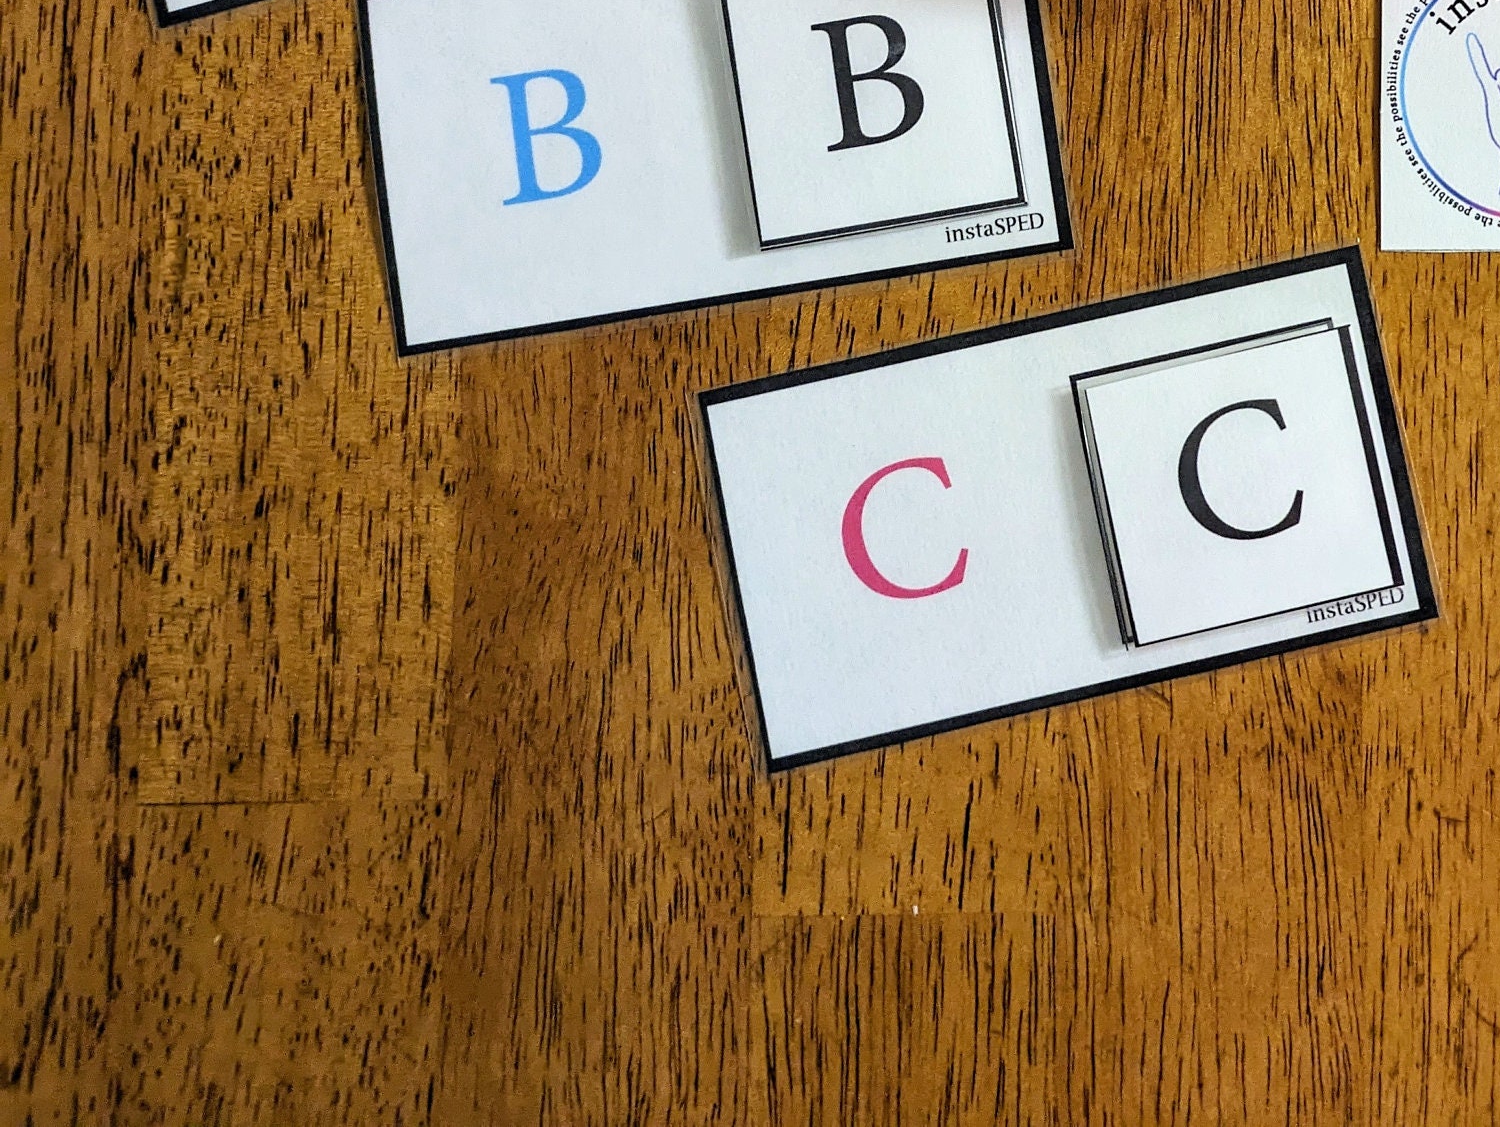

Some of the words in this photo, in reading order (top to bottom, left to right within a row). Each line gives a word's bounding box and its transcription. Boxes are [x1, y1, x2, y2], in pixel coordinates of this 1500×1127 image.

[1406, 7, 1420, 24] the
[1397, 28, 1408, 45] see
[811, 15, 924, 151] B
[1387, 50, 1403, 122] possibilities
[490, 69, 602, 206] B
[1396, 127, 1407, 146] the
[1406, 149, 1418, 166] see
[945, 212, 1045, 243] instaSPED
[1475, 213, 1493, 227] the
[1178, 399, 1303, 540] C
[842, 458, 968, 598] C
[1306, 587, 1405, 623] instaSPED
